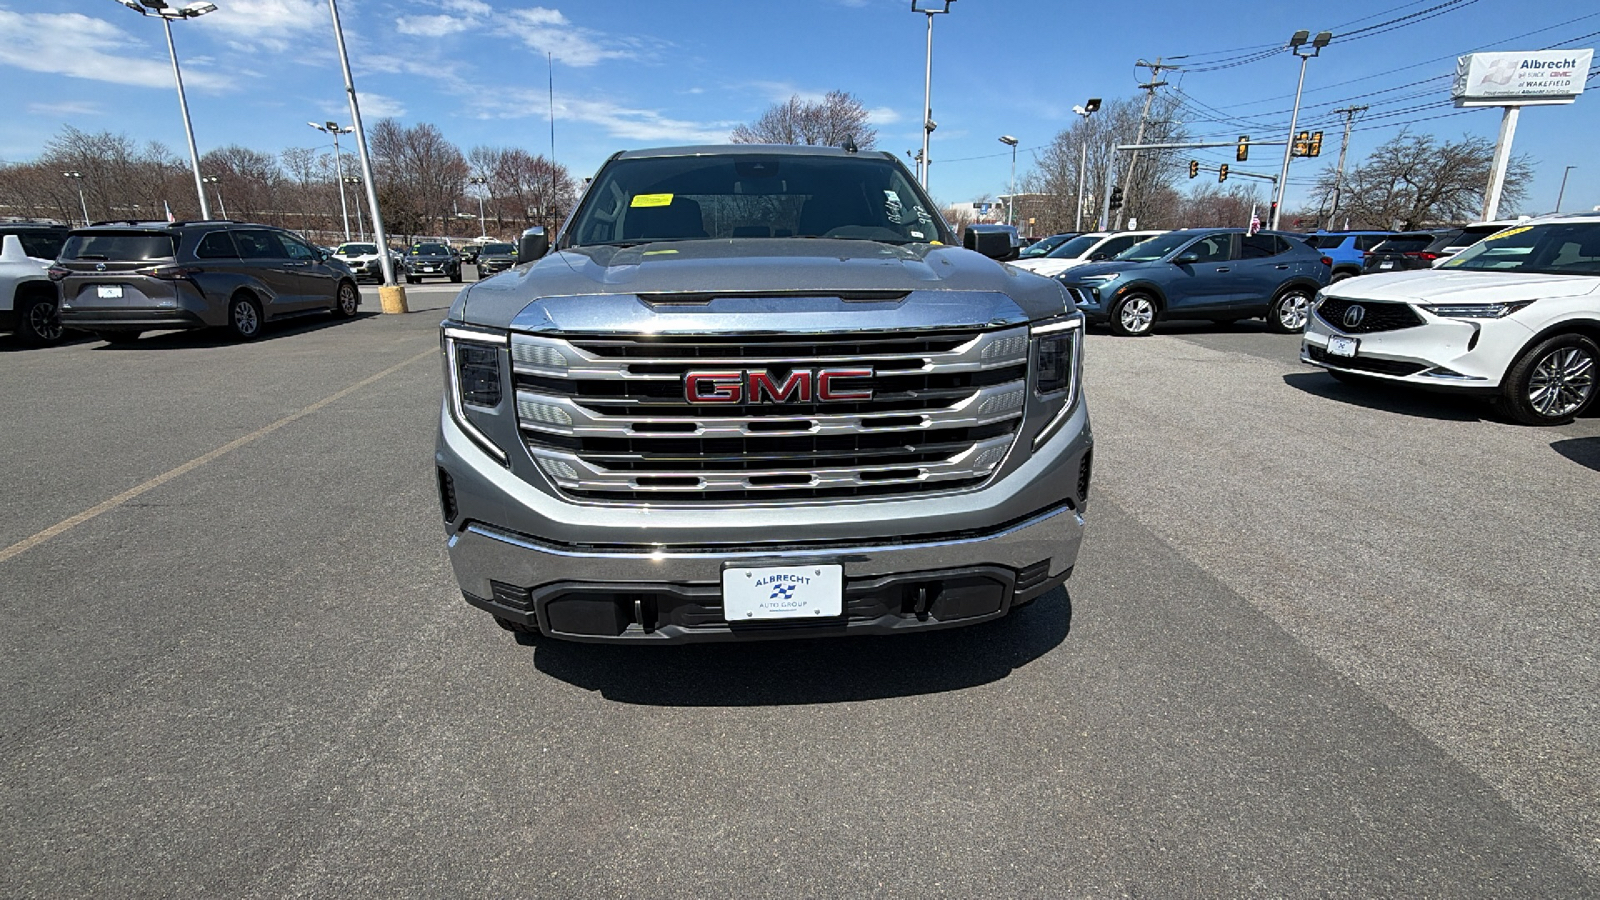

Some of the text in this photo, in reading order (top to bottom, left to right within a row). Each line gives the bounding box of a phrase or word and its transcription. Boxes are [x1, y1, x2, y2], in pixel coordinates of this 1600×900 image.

[1520, 58, 1576, 69] Albrecht
[684, 367, 874, 404] GMC
[755, 574, 811, 587] ALBRECHT
